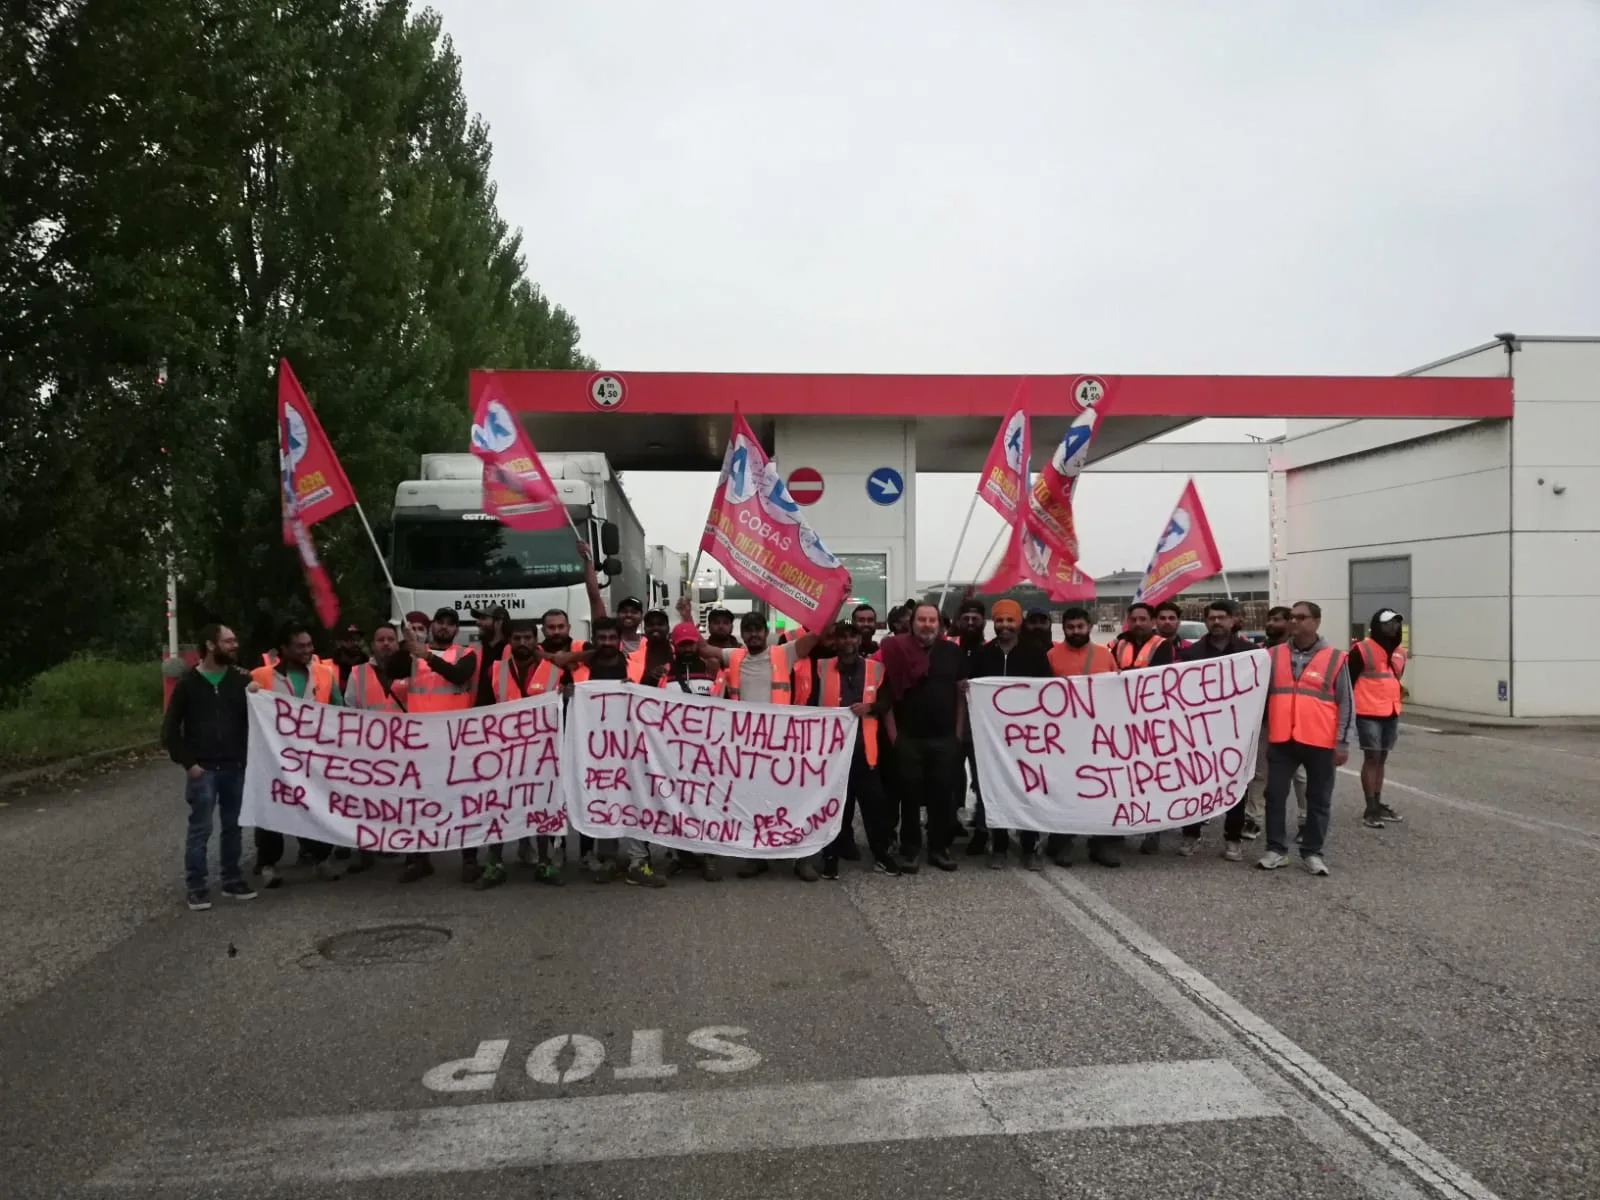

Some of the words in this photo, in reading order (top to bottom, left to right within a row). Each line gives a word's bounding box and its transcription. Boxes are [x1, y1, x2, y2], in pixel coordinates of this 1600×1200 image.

[739, 509, 792, 551] COBAS
[454, 599, 526, 610] BASTASINI
[794, 591, 816, 609] Cobas
[992, 677, 1096, 719] CON
[1124, 655, 1260, 715] VERCELLI
[274, 698, 429, 752] BELFIORE
[730, 711, 845, 757] MALATTIA
[1004, 722, 1065, 755] PER
[1091, 704, 1239, 761] AUMENTI
[280, 747, 421, 789] STESSA
[447, 736, 560, 786] LOTTA
[584, 767, 632, 791] PER
[588, 729, 649, 764] UNA
[667, 739, 828, 787] TANTUM
[1017, 758, 1049, 795] DI
[1075, 747, 1243, 799] STIPENDIO
[271, 778, 310, 811] PER
[329, 791, 453, 827] REDDITO,
[587, 799, 743, 842] SOSPENSIONI
[753, 806, 793, 830] PER
[753, 797, 840, 848] NESSUNO
[1112, 801, 1161, 827] ADL
[1167, 780, 1239, 821] COBAS
[421, 1024, 763, 1093] STOP
